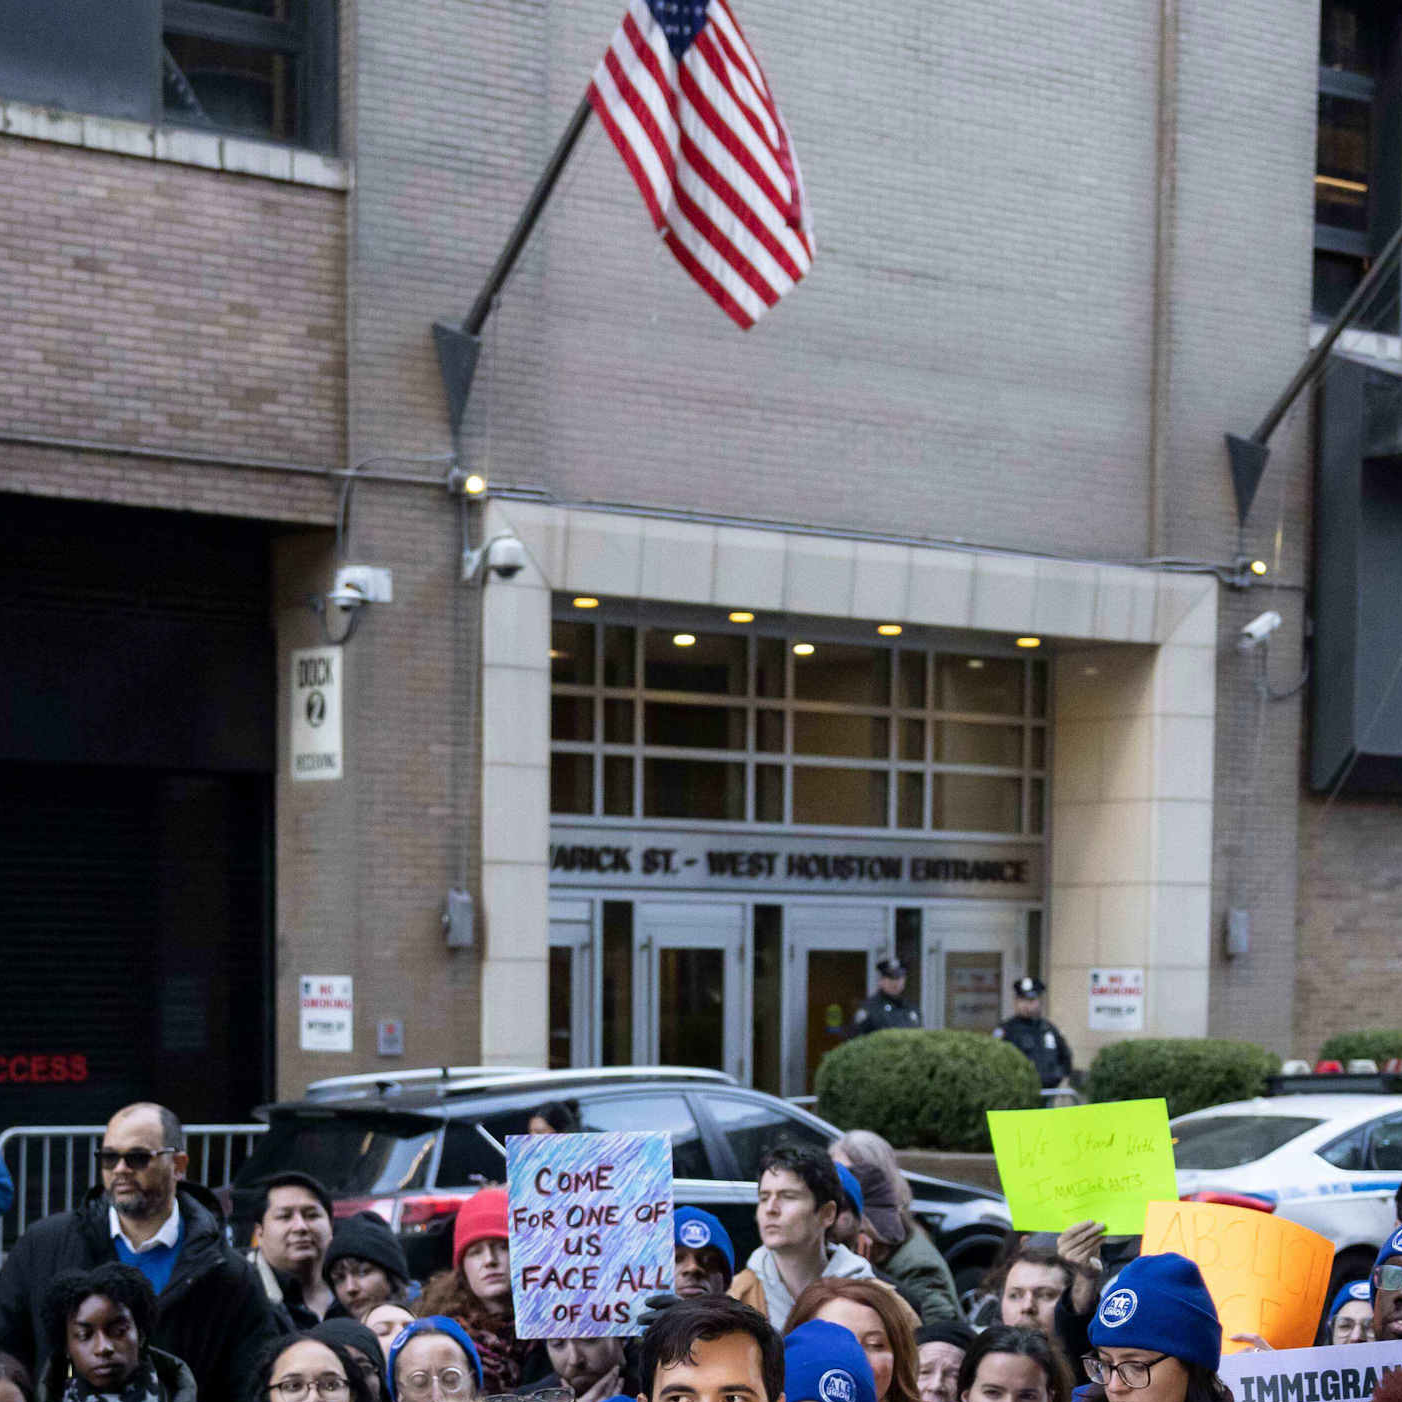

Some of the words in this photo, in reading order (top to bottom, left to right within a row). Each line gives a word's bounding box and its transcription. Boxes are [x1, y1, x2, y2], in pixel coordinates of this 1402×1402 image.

[299, 657, 335, 688] DOCK
[707, 851, 779, 878] WEST
[786, 853, 903, 880] HOUSTON
[910, 858, 1029, 883] ENTRANCE
[534, 1165, 614, 1197] COME
[513, 1206, 557, 1233] FOR
[566, 1204, 620, 1229] ONE
[635, 1201, 668, 1224] OF
[563, 1233, 603, 1257] US
[522, 1265, 601, 1291] FACE
[615, 1264, 671, 1293] ALL
[552, 1303, 583, 1324] OF
[591, 1301, 631, 1324] US
